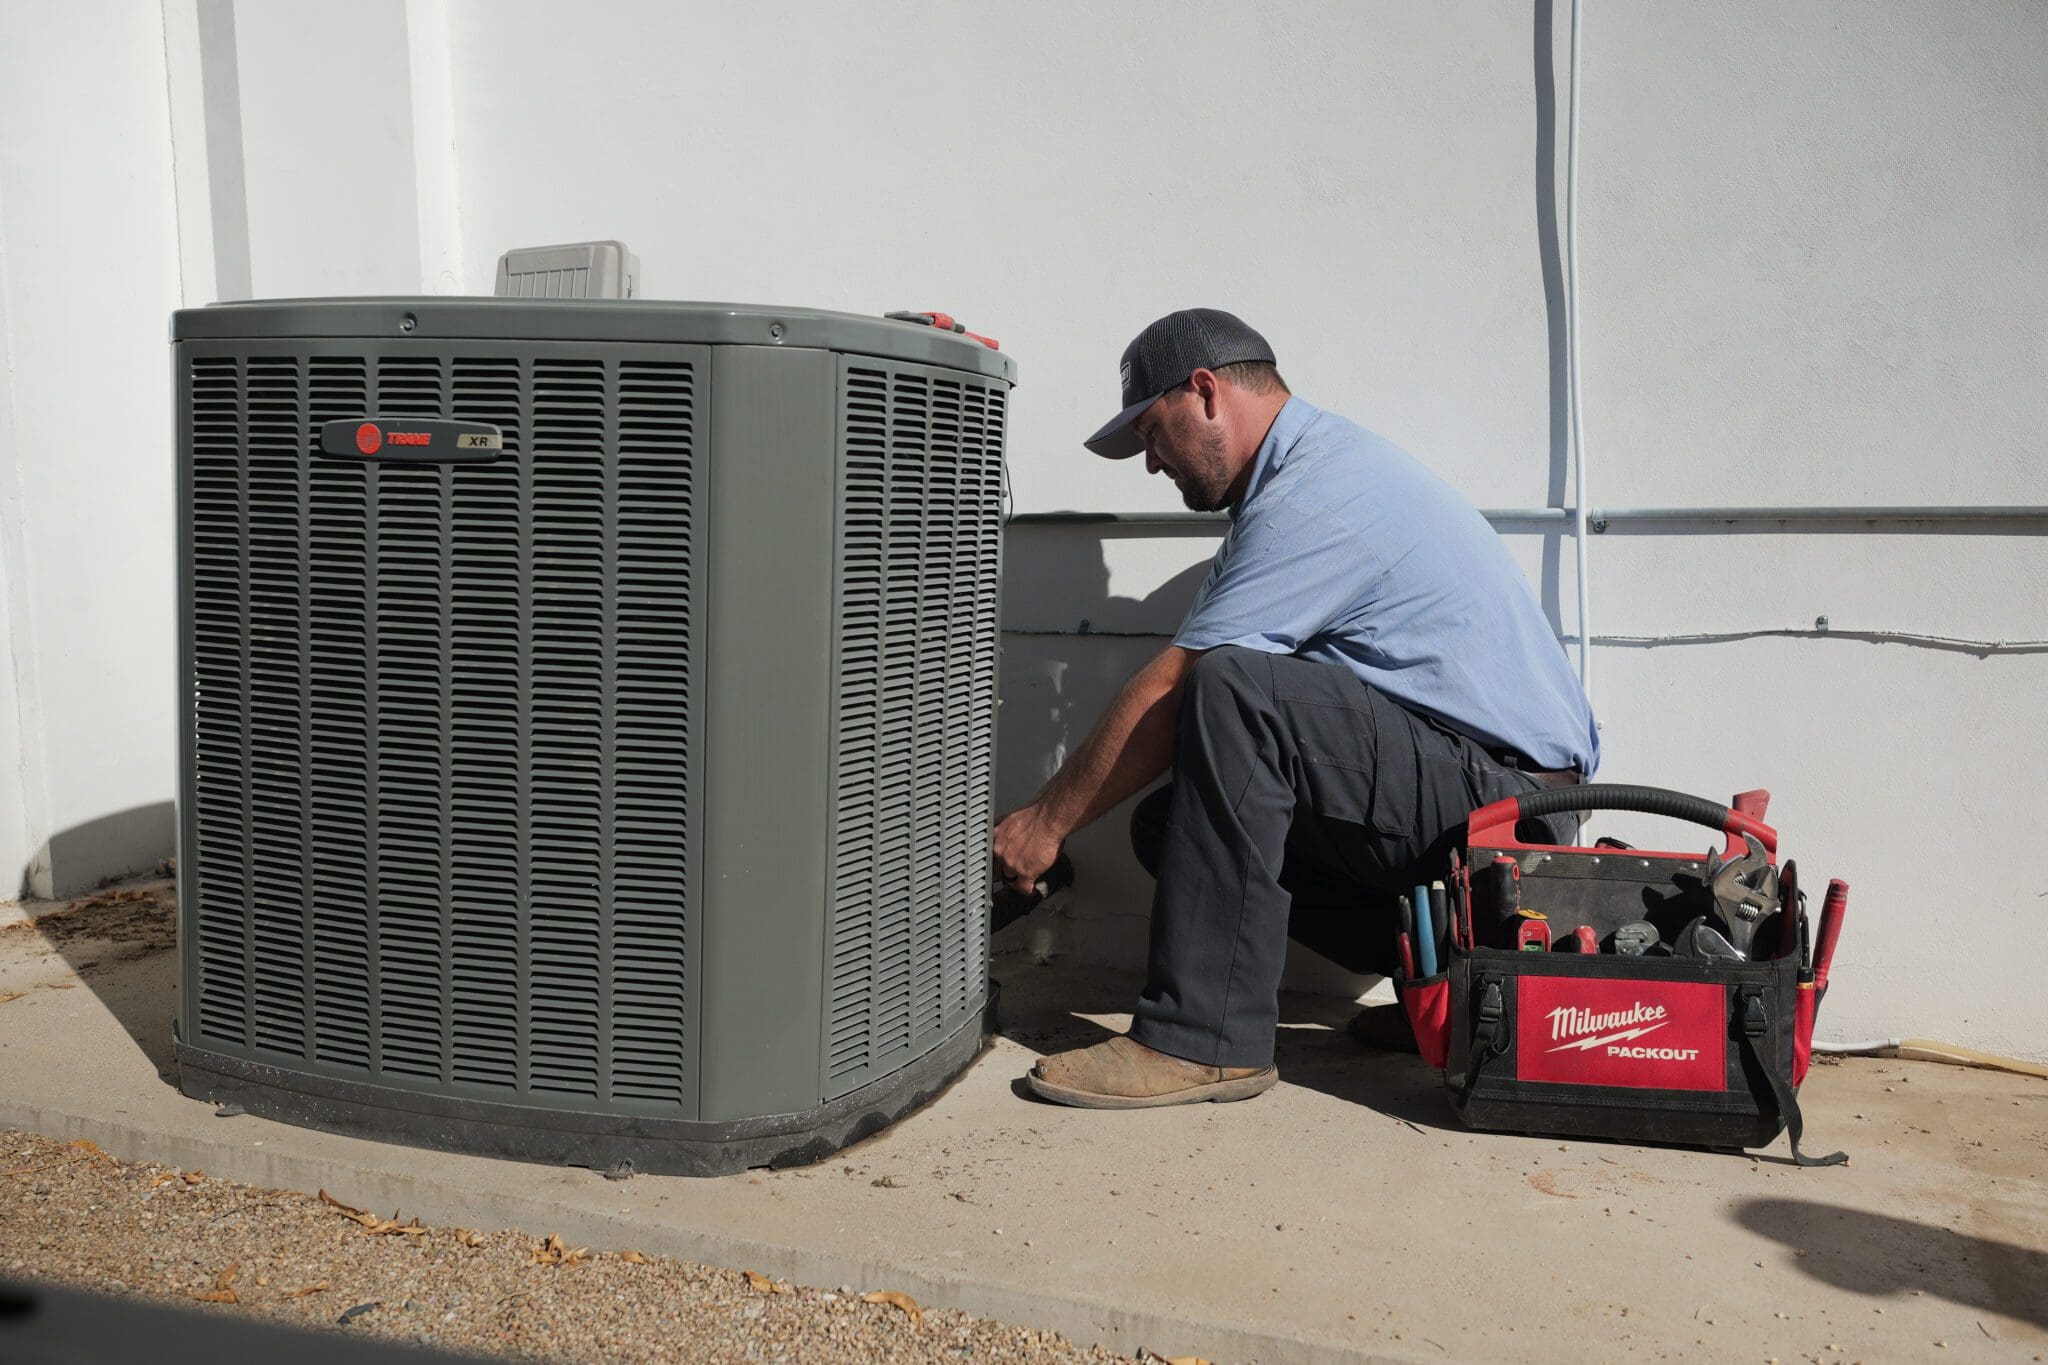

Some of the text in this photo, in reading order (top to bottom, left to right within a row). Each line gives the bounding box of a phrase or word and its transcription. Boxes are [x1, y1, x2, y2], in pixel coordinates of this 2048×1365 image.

[386, 432, 432, 446] TRANE
[469, 437, 488, 447] XR
[1544, 1001, 1668, 1041] Milwaukee
[1607, 1046, 1700, 1061] PACKOUT
